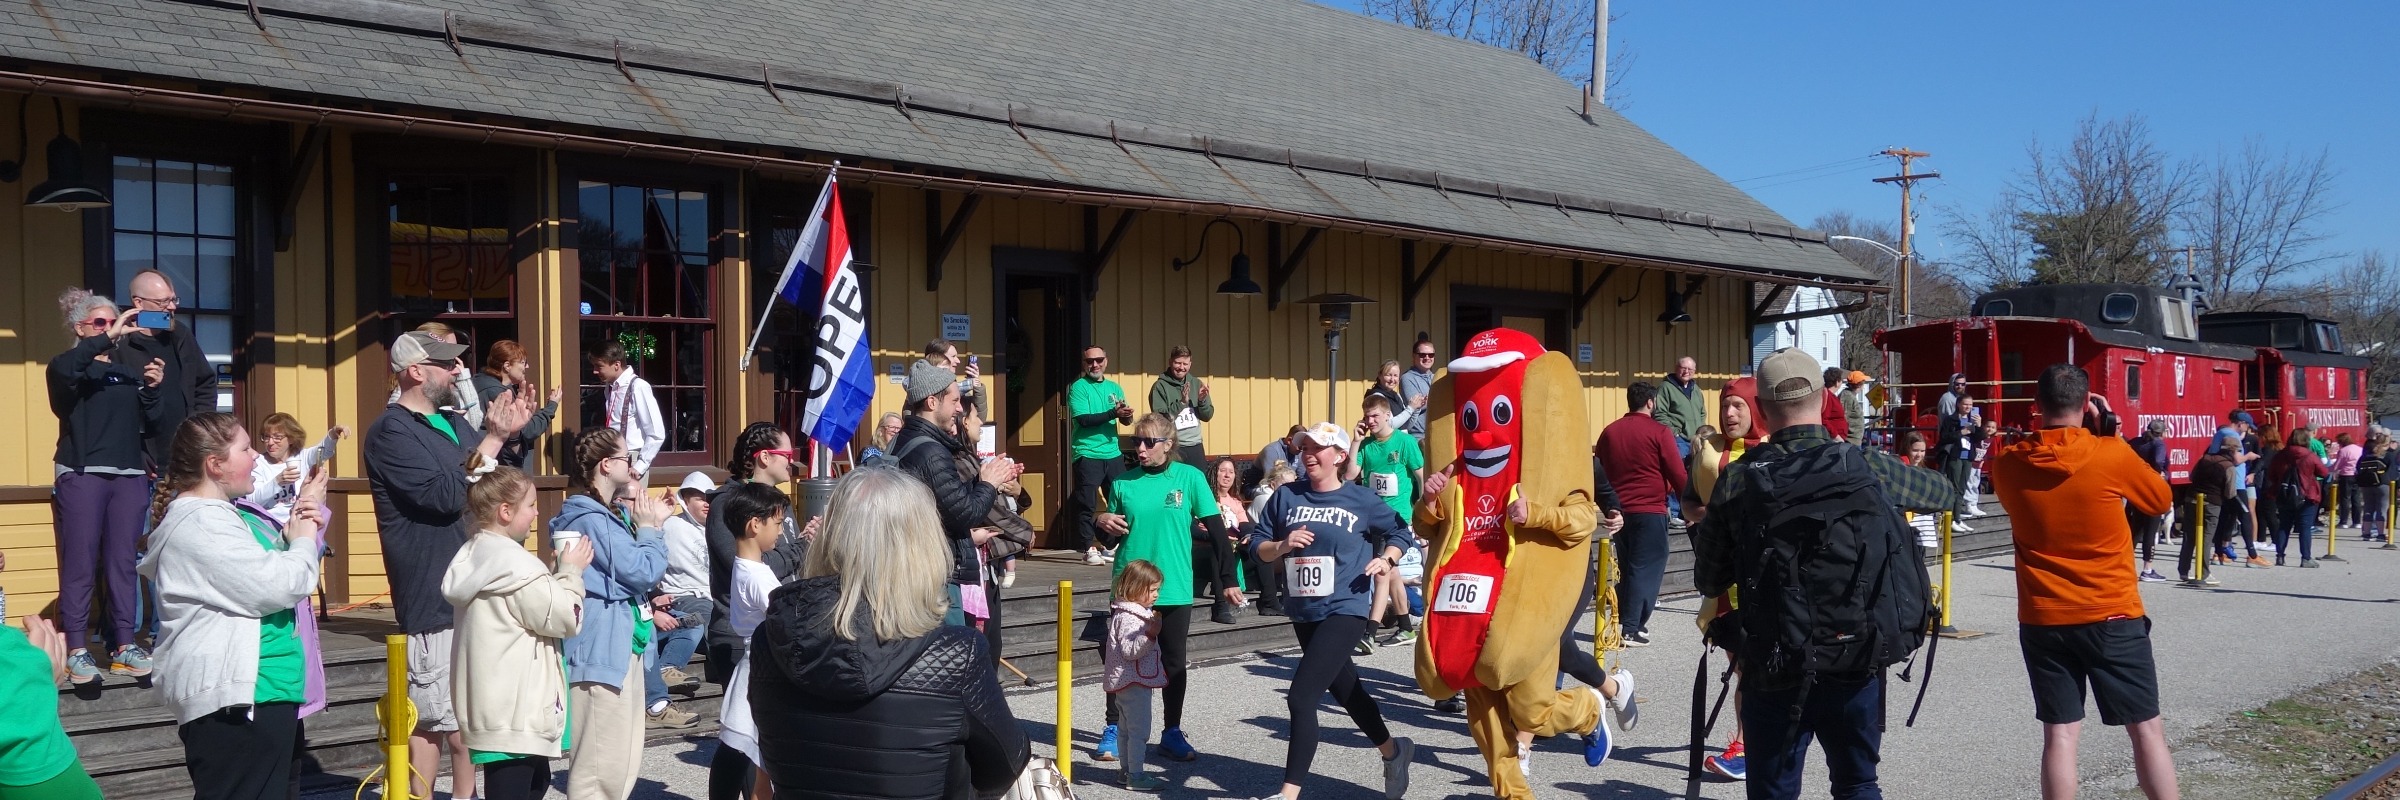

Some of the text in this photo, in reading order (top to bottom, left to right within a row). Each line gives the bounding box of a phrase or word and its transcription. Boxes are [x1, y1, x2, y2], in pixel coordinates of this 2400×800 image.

[807, 258, 864, 399] OPE
[1473, 338, 1498, 348] YORK
[1376, 479, 1387, 490] 84
[1286, 506, 1358, 533] LIBERTY
[1465, 514, 1503, 531] YORK
[1296, 566, 1321, 587] 109
[1449, 583, 1477, 603] 106
